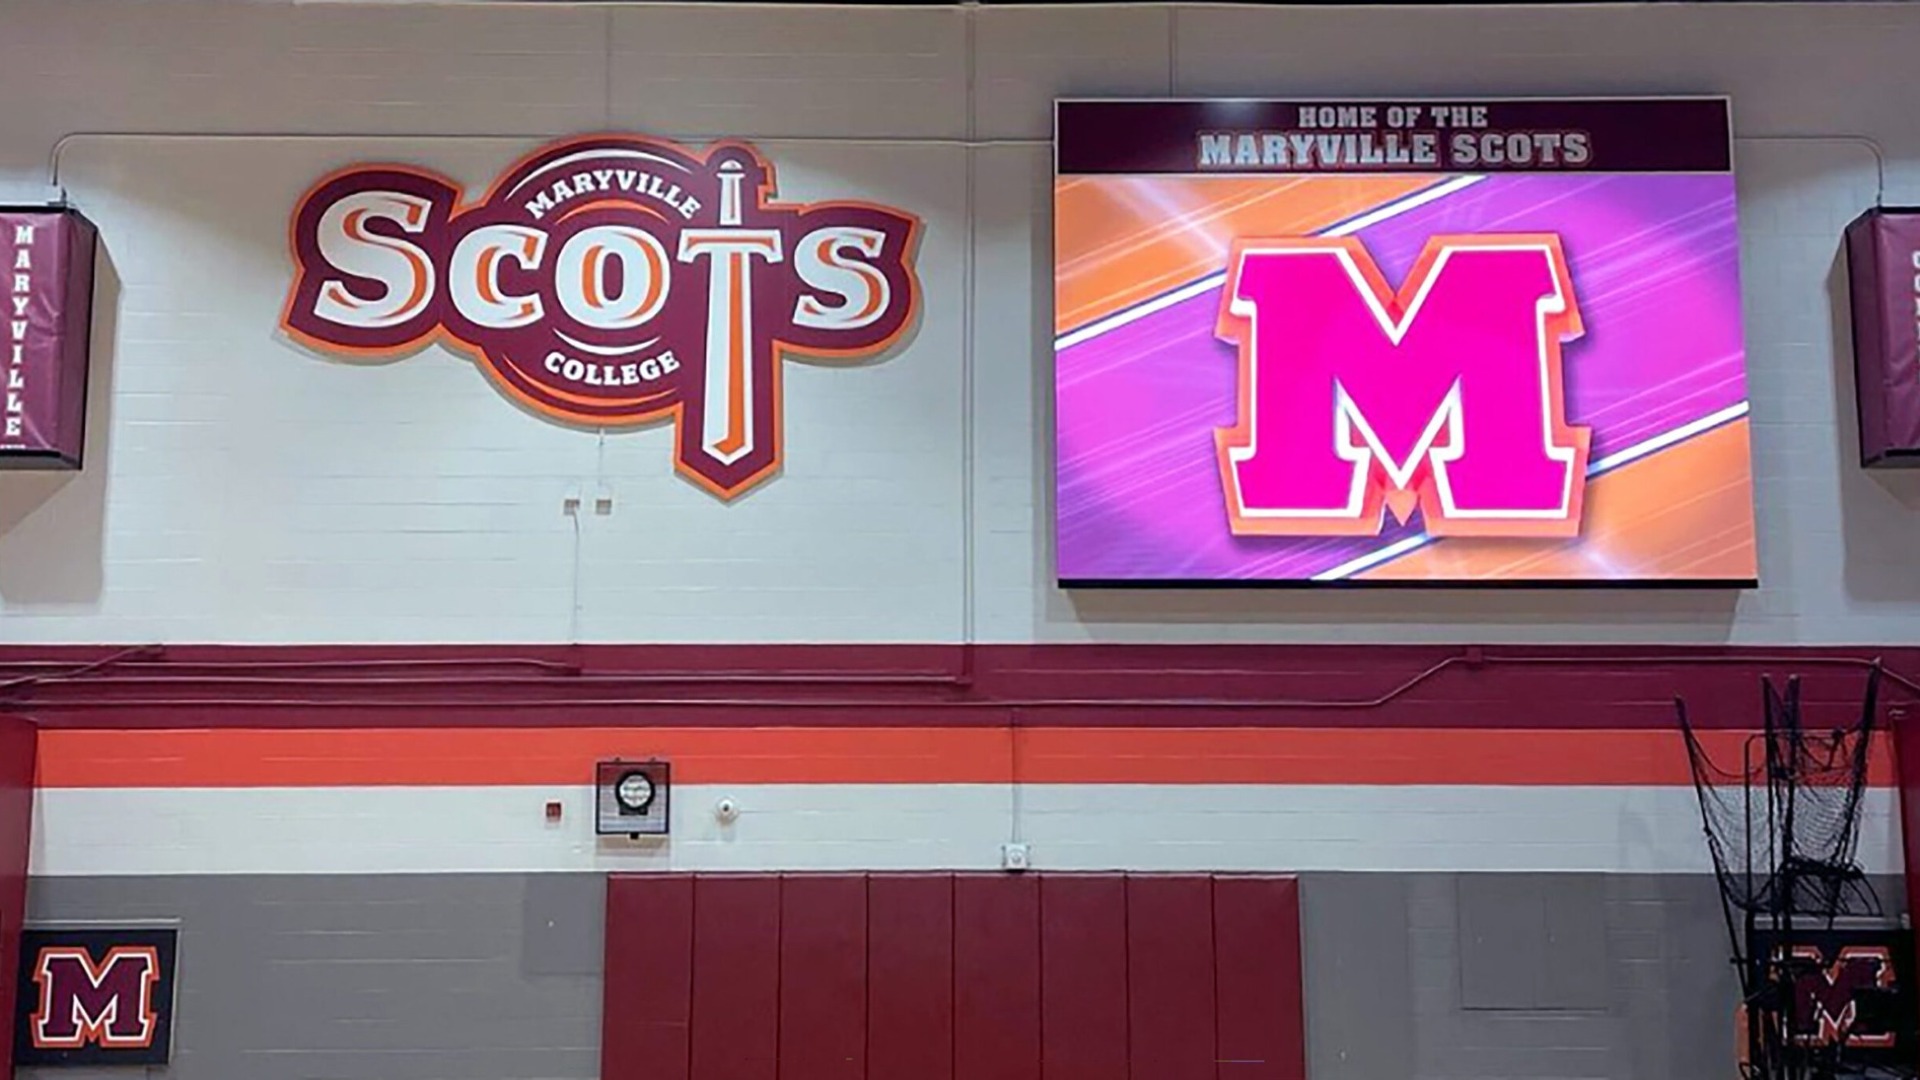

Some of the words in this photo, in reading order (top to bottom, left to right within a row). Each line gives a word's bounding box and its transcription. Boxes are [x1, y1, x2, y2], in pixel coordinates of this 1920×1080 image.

[1199, 133, 1437, 165] MARYVILLE
[1452, 133, 1589, 164] SCOTS
[1299, 106, 1377, 128] HOME
[1386, 106, 1421, 128] OF
[1431, 106, 1488, 128] THE
[524, 169, 701, 221] MARYVILLE
[5, 225, 35, 437] MARYVILLE
[314, 190, 892, 466] SCOTS
[544, 350, 680, 386] COLLEGE
[1214, 233, 1592, 537] M
[30, 946, 160, 1048] M
